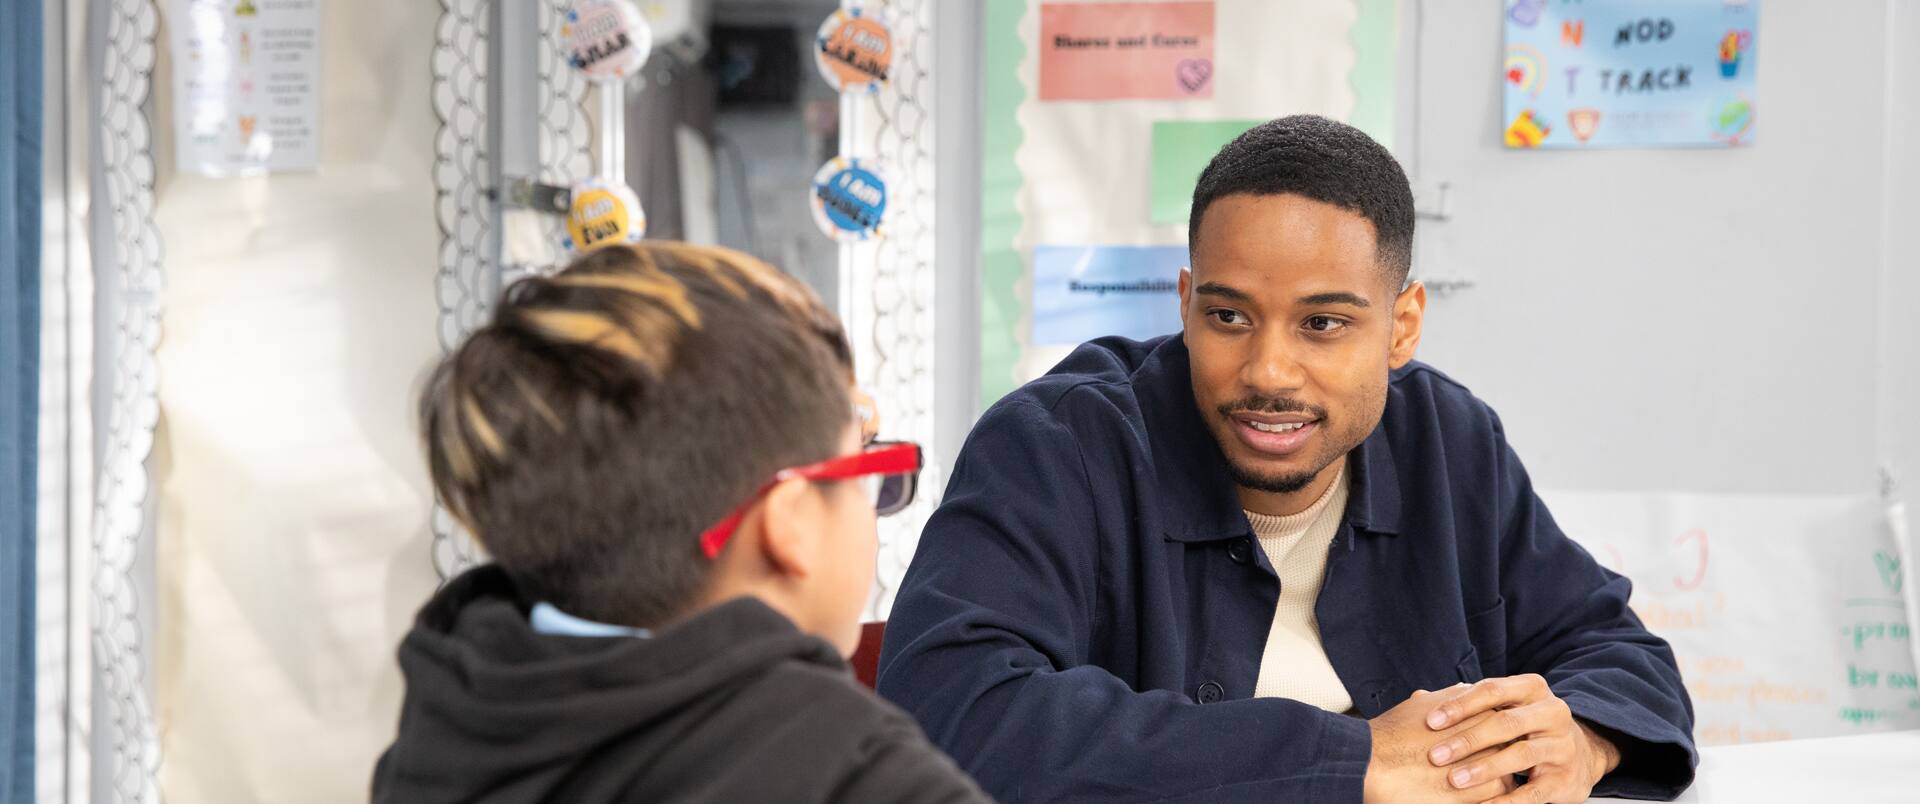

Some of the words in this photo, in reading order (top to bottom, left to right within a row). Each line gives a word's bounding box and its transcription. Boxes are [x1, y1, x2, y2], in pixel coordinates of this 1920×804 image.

[1562, 20, 1585, 47] N
[1615, 18, 1676, 47] NOD
[1564, 67, 1581, 95] T
[1601, 66, 1694, 95] TRACK
